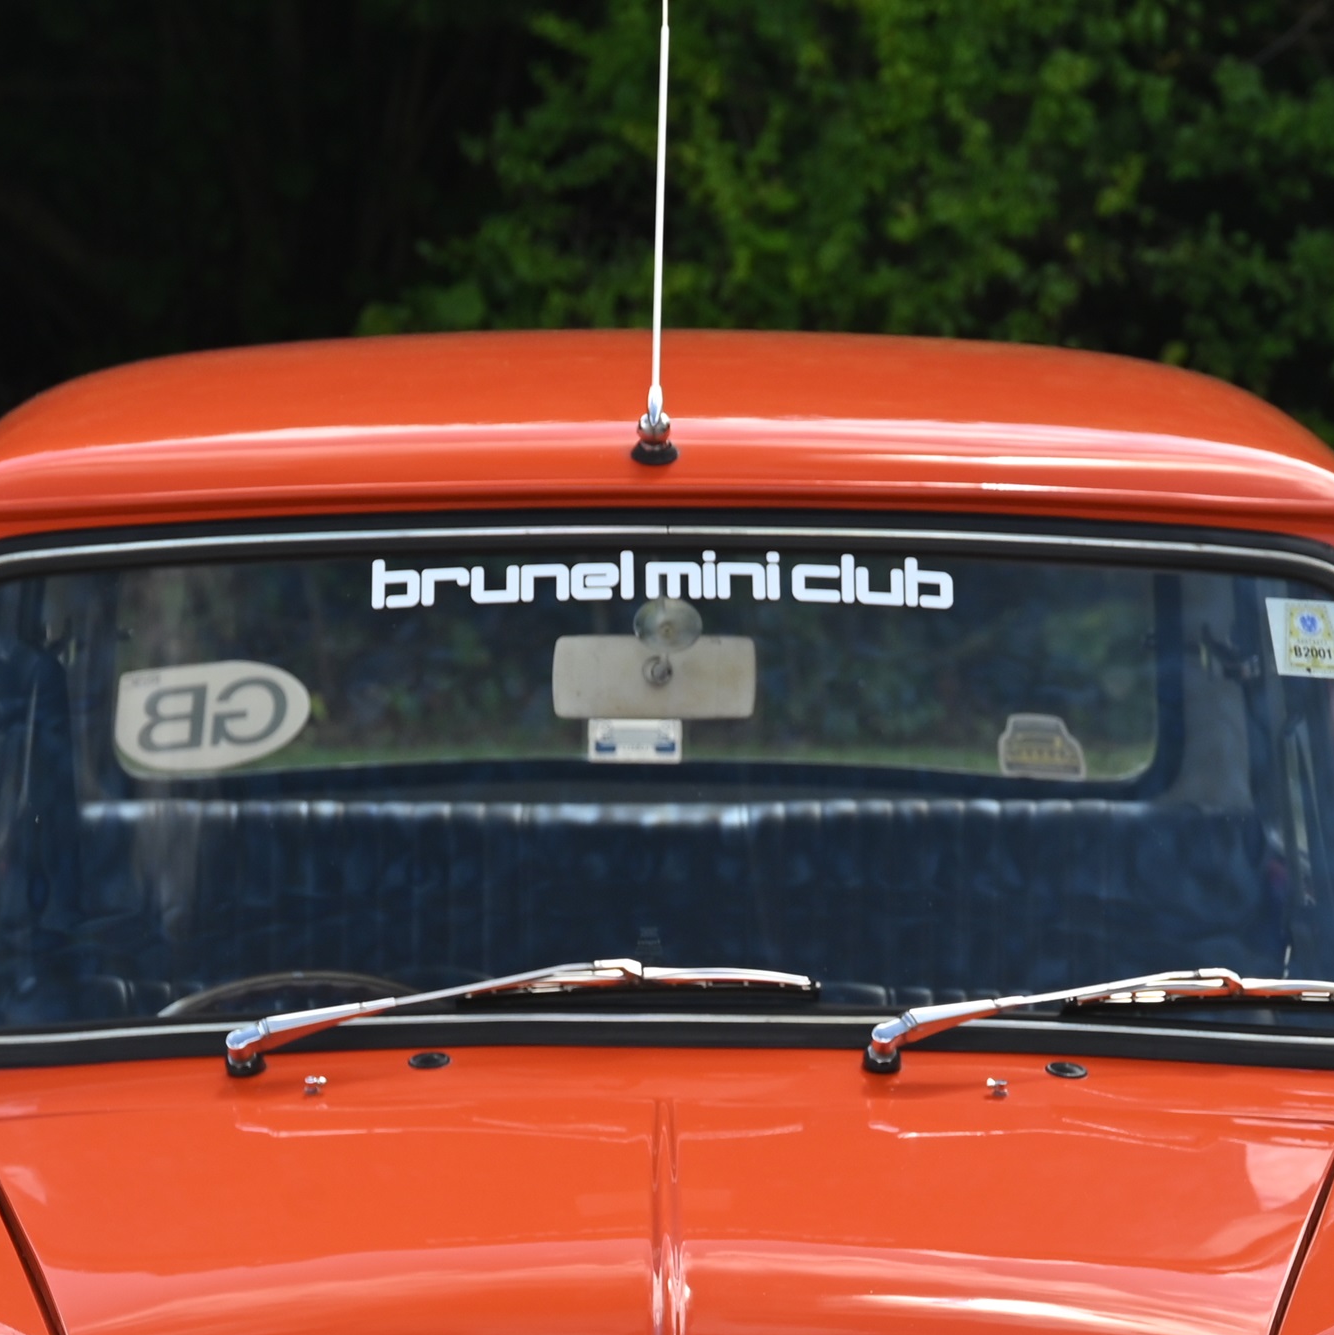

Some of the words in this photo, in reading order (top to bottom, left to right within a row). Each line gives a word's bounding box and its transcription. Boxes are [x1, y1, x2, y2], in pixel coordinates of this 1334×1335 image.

[371, 551, 634, 609] brunel
[646, 551, 780, 600] mini
[792, 554, 954, 609] club
[1293, 645, 1332, 660] B2001
